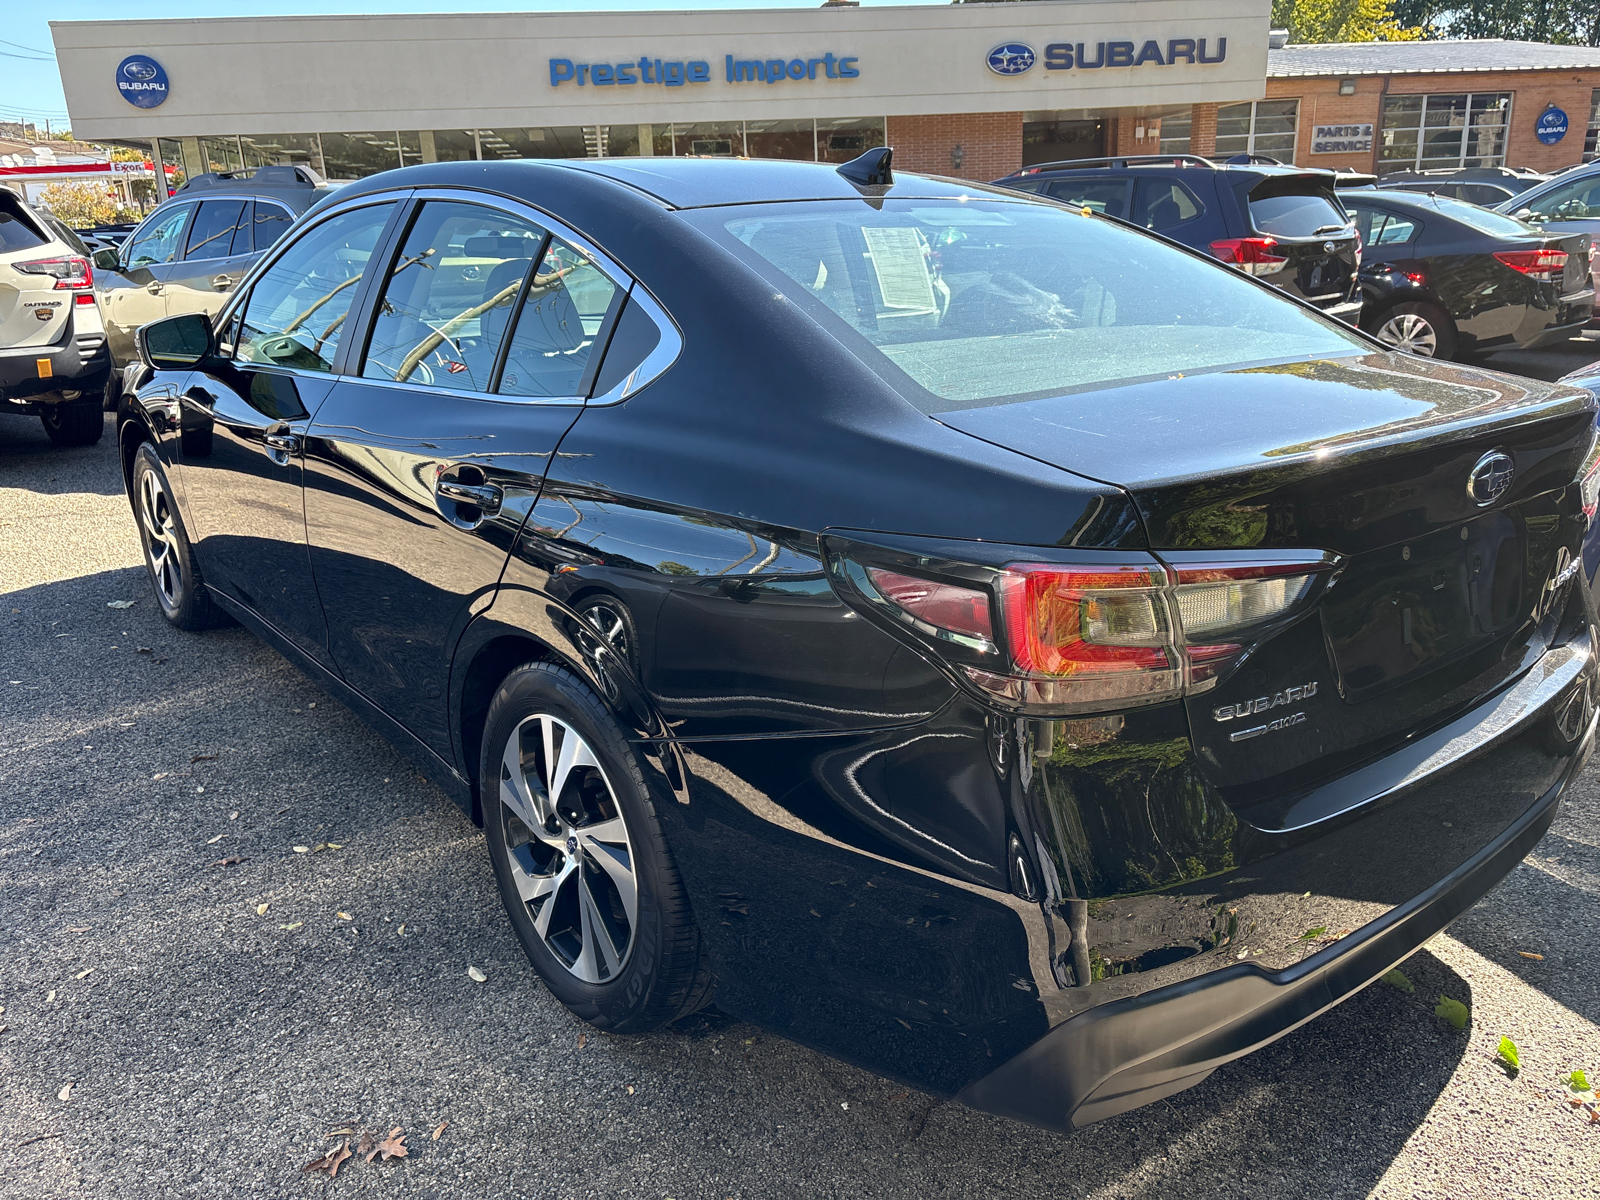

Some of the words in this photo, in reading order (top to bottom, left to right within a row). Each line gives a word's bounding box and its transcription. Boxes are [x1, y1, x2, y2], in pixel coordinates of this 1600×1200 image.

[1044, 37, 1227, 70] SUBARU
[549, 56, 711, 87] Prestige
[725, 52, 860, 84] Imports
[119, 82, 165, 91] SUBARU
[1316, 125, 1360, 138] PARTS
[1363, 125, 1372, 136] &
[1538, 126, 1566, 134] SUBARU
[1314, 140, 1372, 152] SERVICE
[114, 163, 142, 174] Exxon
[1212, 681, 1318, 721] SUBARU
[1261, 711, 1307, 735] AWD
